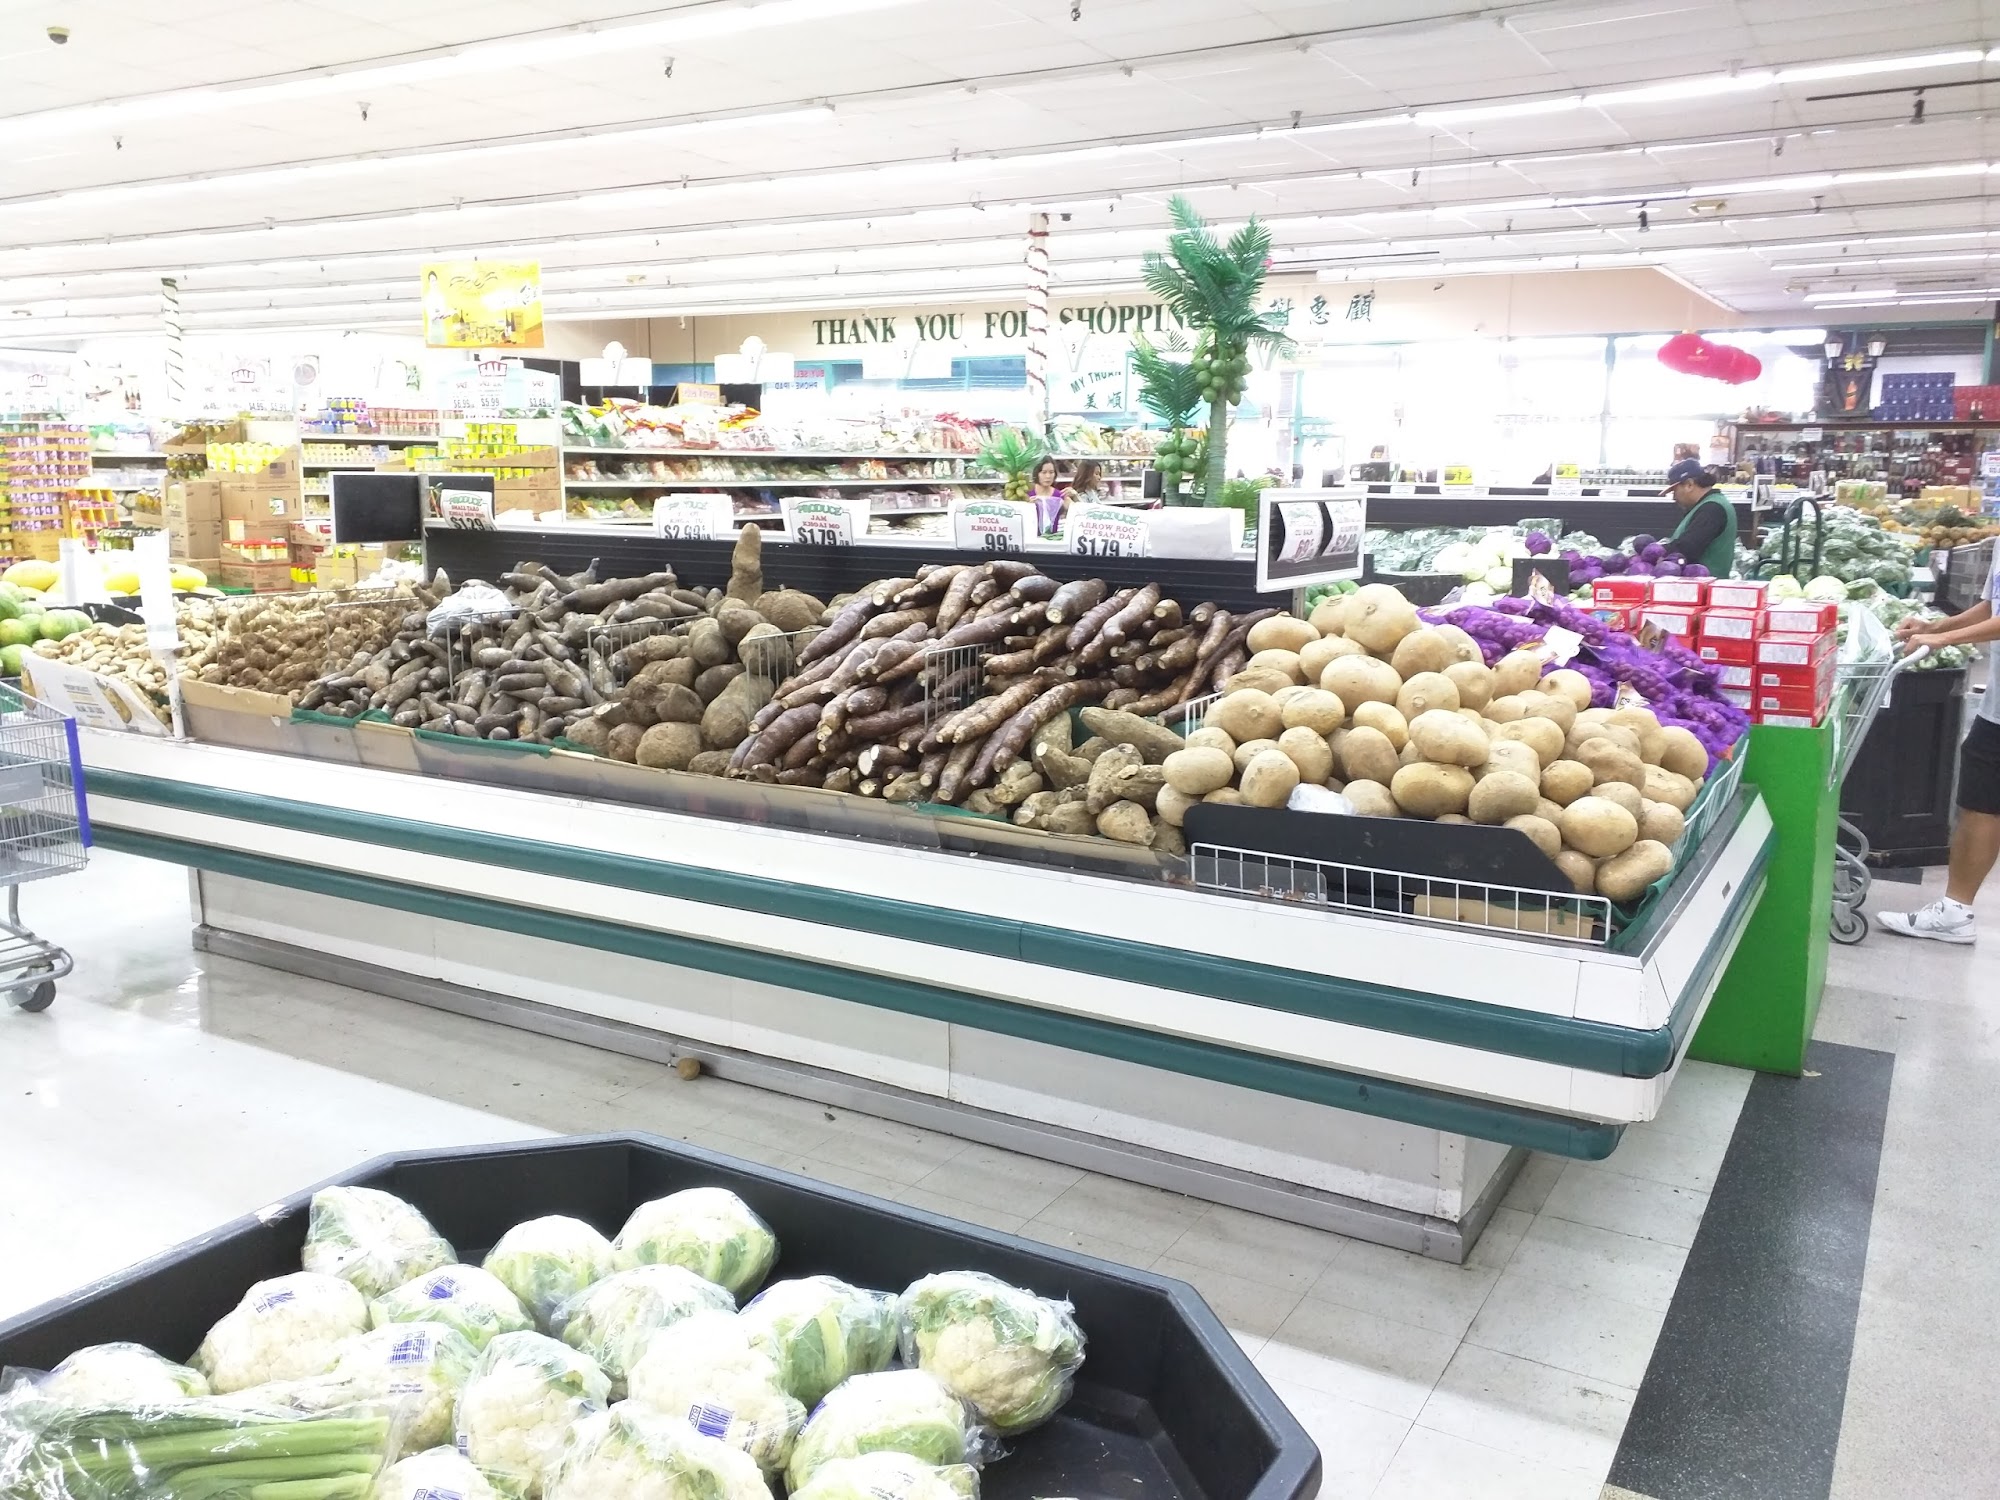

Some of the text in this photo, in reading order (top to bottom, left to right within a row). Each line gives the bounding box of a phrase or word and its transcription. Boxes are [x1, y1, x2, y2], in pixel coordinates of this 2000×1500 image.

[813, 317, 896, 345] THANK
[914, 312, 965, 341] YOU
[1070, 376, 1085, 394] MY
[797, 504, 843, 516] PRODUCE
[965, 505, 1015, 518] PRODUCE
[1086, 510, 1140, 525] PRODUCE
[664, 524, 700, 540] $2.99
[1079, 522, 1113, 530] ARROW
[797, 526, 837, 546] $1.79
[1119, 533, 1138, 541] DAY
[1077, 535, 1120, 556] $1.79
